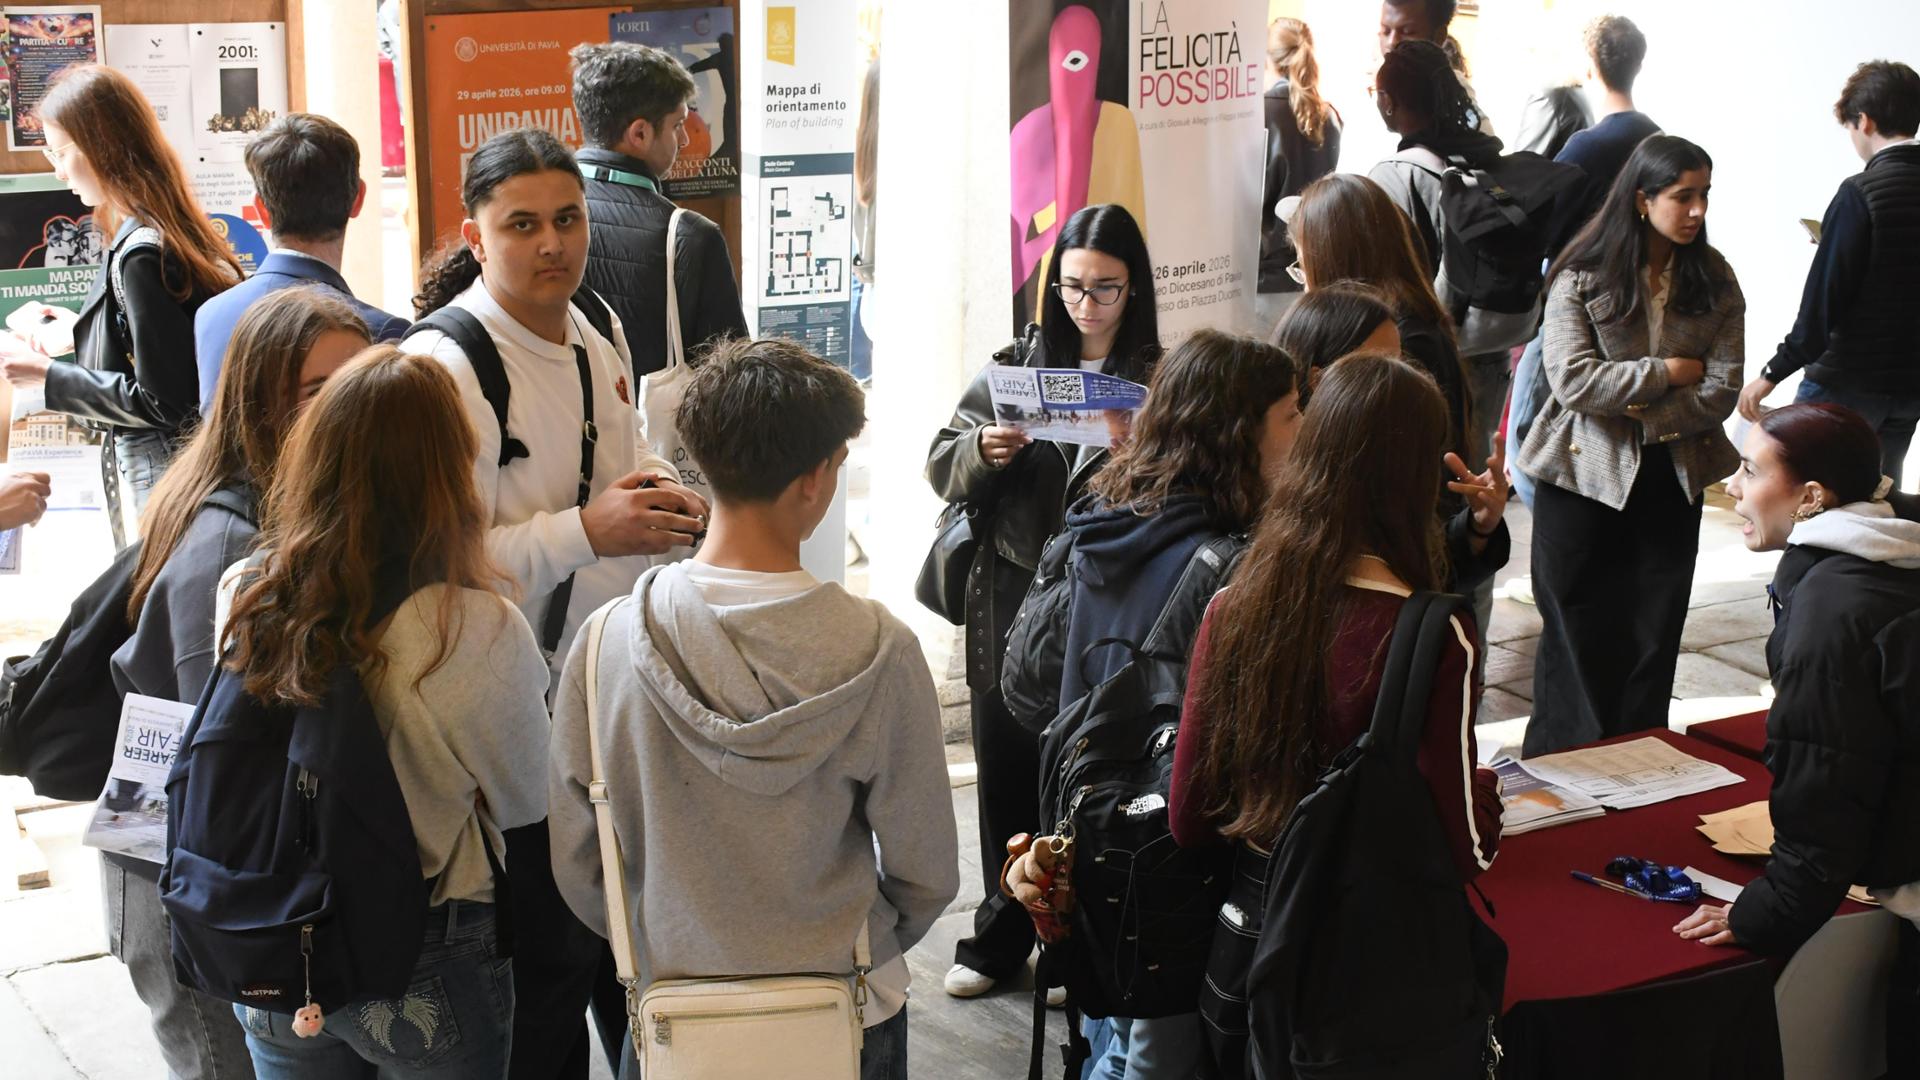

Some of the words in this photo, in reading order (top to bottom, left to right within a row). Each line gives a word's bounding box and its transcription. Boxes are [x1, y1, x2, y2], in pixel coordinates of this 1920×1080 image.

[1140, 0, 1170, 35] LA
[19, 38, 50, 46] PARTITA
[480, 40, 526, 53] UNIVERSITÀ
[527, 42, 536, 51] DI
[537, 40, 560, 49] PAVIA
[1140, 21, 1241, 72] FELICITÀ
[218, 45, 258, 58] 2001:
[457, 91, 469, 100] 29
[472, 88, 496, 101] aprile
[525, 88, 539, 96] ore
[541, 84, 566, 95] 09.00
[766, 85, 806, 98] Mappa
[810, 83, 821, 94] di
[1140, 64, 1258, 109] POSSIBILE
[766, 100, 847, 112] orientamento
[766, 118, 787, 128] Plan
[790, 117, 801, 130] of
[802, 115, 844, 128] building
[676, 157, 730, 169] RACCONTI
[670, 169, 704, 179] DELLA
[707, 166, 738, 177] LUNA
[1172, 260, 1206, 278] aprile
[1208, 254, 1231, 272] 2026
[49, 270, 73, 284] MA
[1, 286, 13, 299] TI
[15, 283, 68, 298] MANDA
[1169, 278, 1215, 295] Diocesano
[1176, 296, 1189, 310] da
[1191, 293, 1216, 308] Piazza
[1002, 378, 1036, 391] FAIR
[1118, 800, 1149, 811] NORTH
[1127, 806, 1150, 816] FACE
